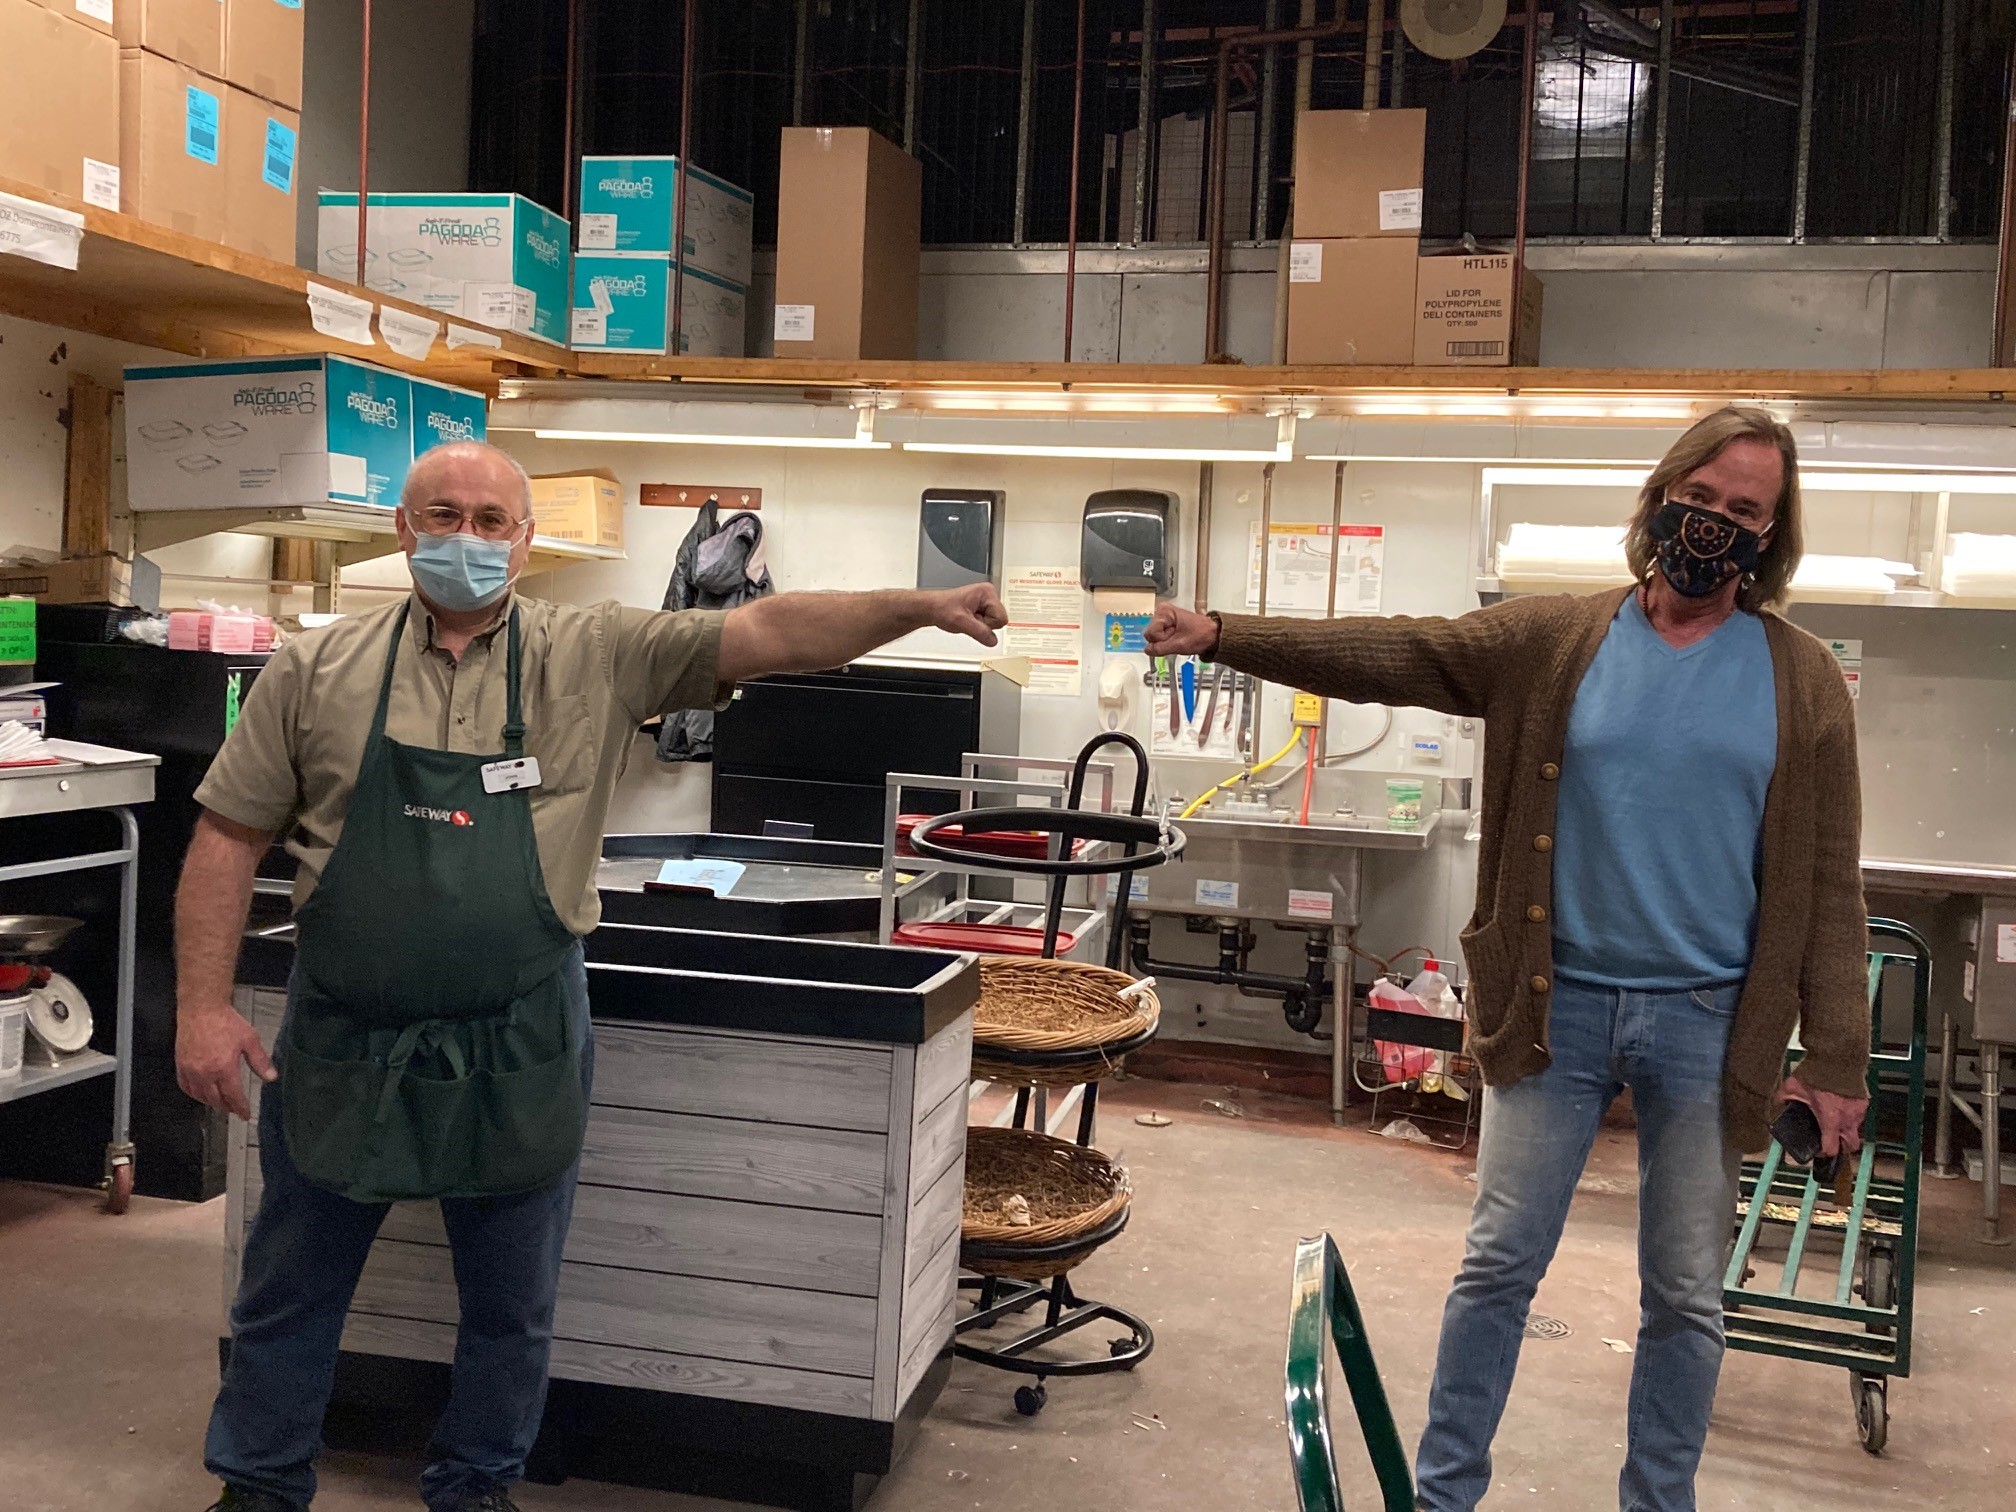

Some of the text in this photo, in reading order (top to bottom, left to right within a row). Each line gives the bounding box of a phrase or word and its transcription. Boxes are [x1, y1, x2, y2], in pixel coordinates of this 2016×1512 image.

[598, 182, 641, 191] PAGODA
[418, 224, 485, 236] PAGODA
[438, 234, 480, 246] WARE
[1463, 259, 1508, 269] HTL115
[1424, 300, 1502, 308] POLYPROPYLENE
[1423, 310, 1503, 319] DELI CONTAINERS
[233, 391, 299, 406] PAGODA
[251, 402, 293, 416] WARE
[347, 395, 389, 416] PAGODA
[427, 415, 465, 434] PAGODA
[485, 764, 511, 773] SAFEWAY
[404, 804, 452, 822] SAFEWAY
